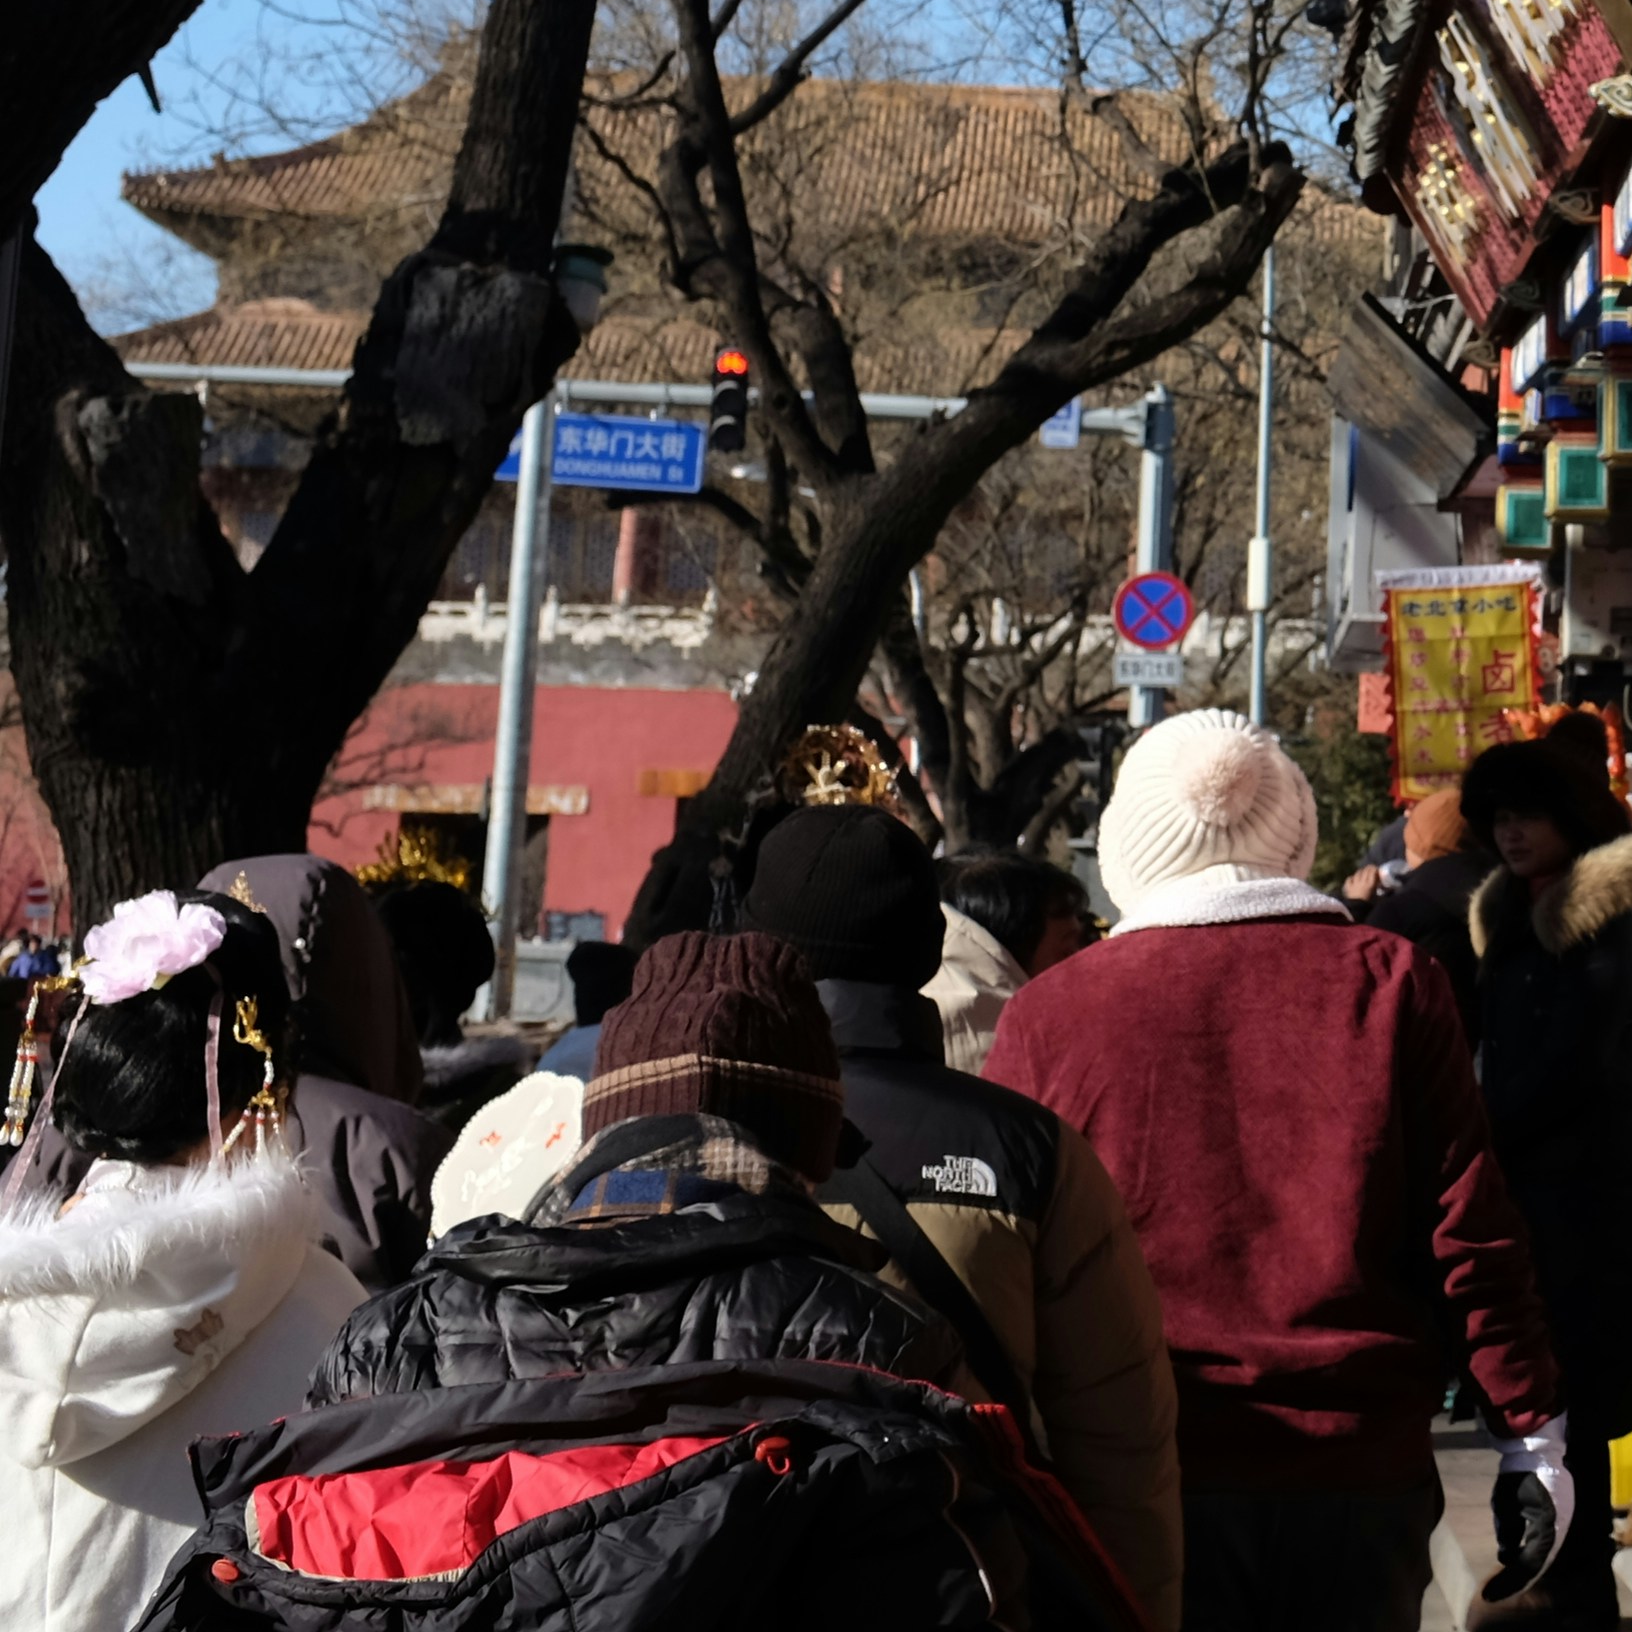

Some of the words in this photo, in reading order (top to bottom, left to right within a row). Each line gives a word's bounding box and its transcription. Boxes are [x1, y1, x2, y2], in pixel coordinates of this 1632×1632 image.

[557, 425, 687, 462] 东华门大街
[1401, 595, 1518, 617] 老北京小吃
[943, 1154, 974, 1170] THE
[921, 1164, 974, 1184] NORTH
[935, 1178, 974, 1194] FACE
